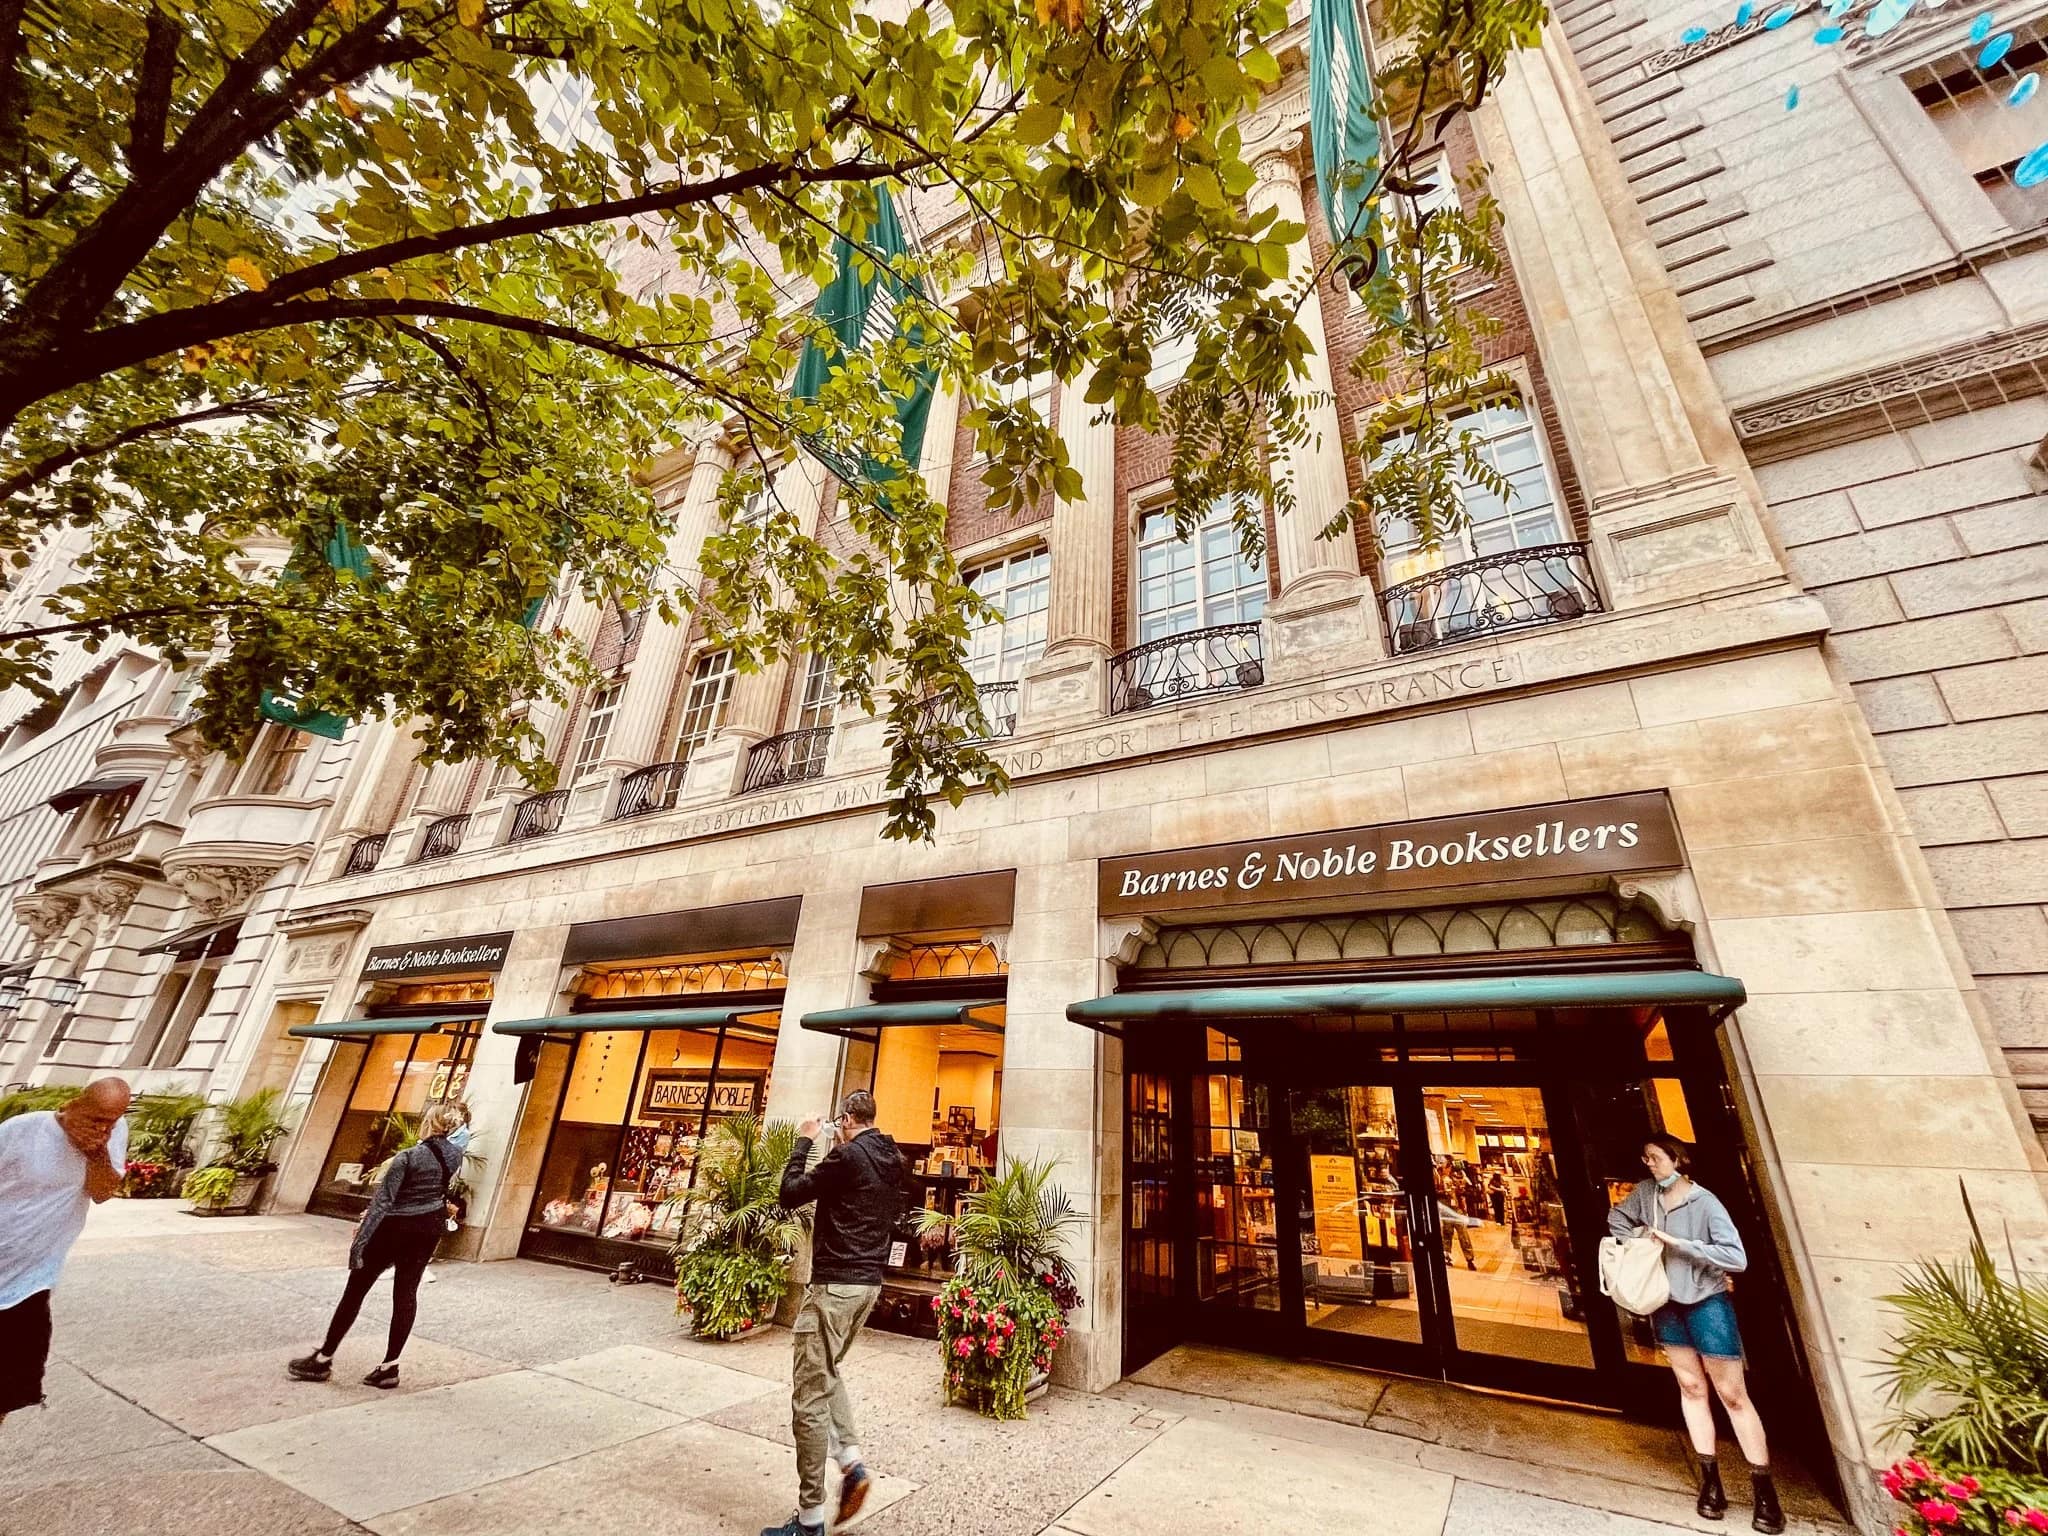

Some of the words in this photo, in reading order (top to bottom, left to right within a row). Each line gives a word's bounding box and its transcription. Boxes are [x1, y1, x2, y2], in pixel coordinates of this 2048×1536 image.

[621, 829, 648, 848] THE
[670, 797, 806, 841] PRESBYTERIAN
[1083, 734, 1135, 761] FOR
[1176, 710, 1246, 744] LIFE
[1294, 658, 1512, 722] INSVRANCE
[1119, 862, 1229, 897] Barnes
[1237, 851, 1267, 889] &
[1274, 845, 1377, 883] Noble
[1386, 819, 1640, 872] Booksellers
[366, 956, 401, 972] Barnes
[399, 950, 412, 971] &
[409, 951, 439, 968] Noble
[438, 945, 502, 965] Booksellers
